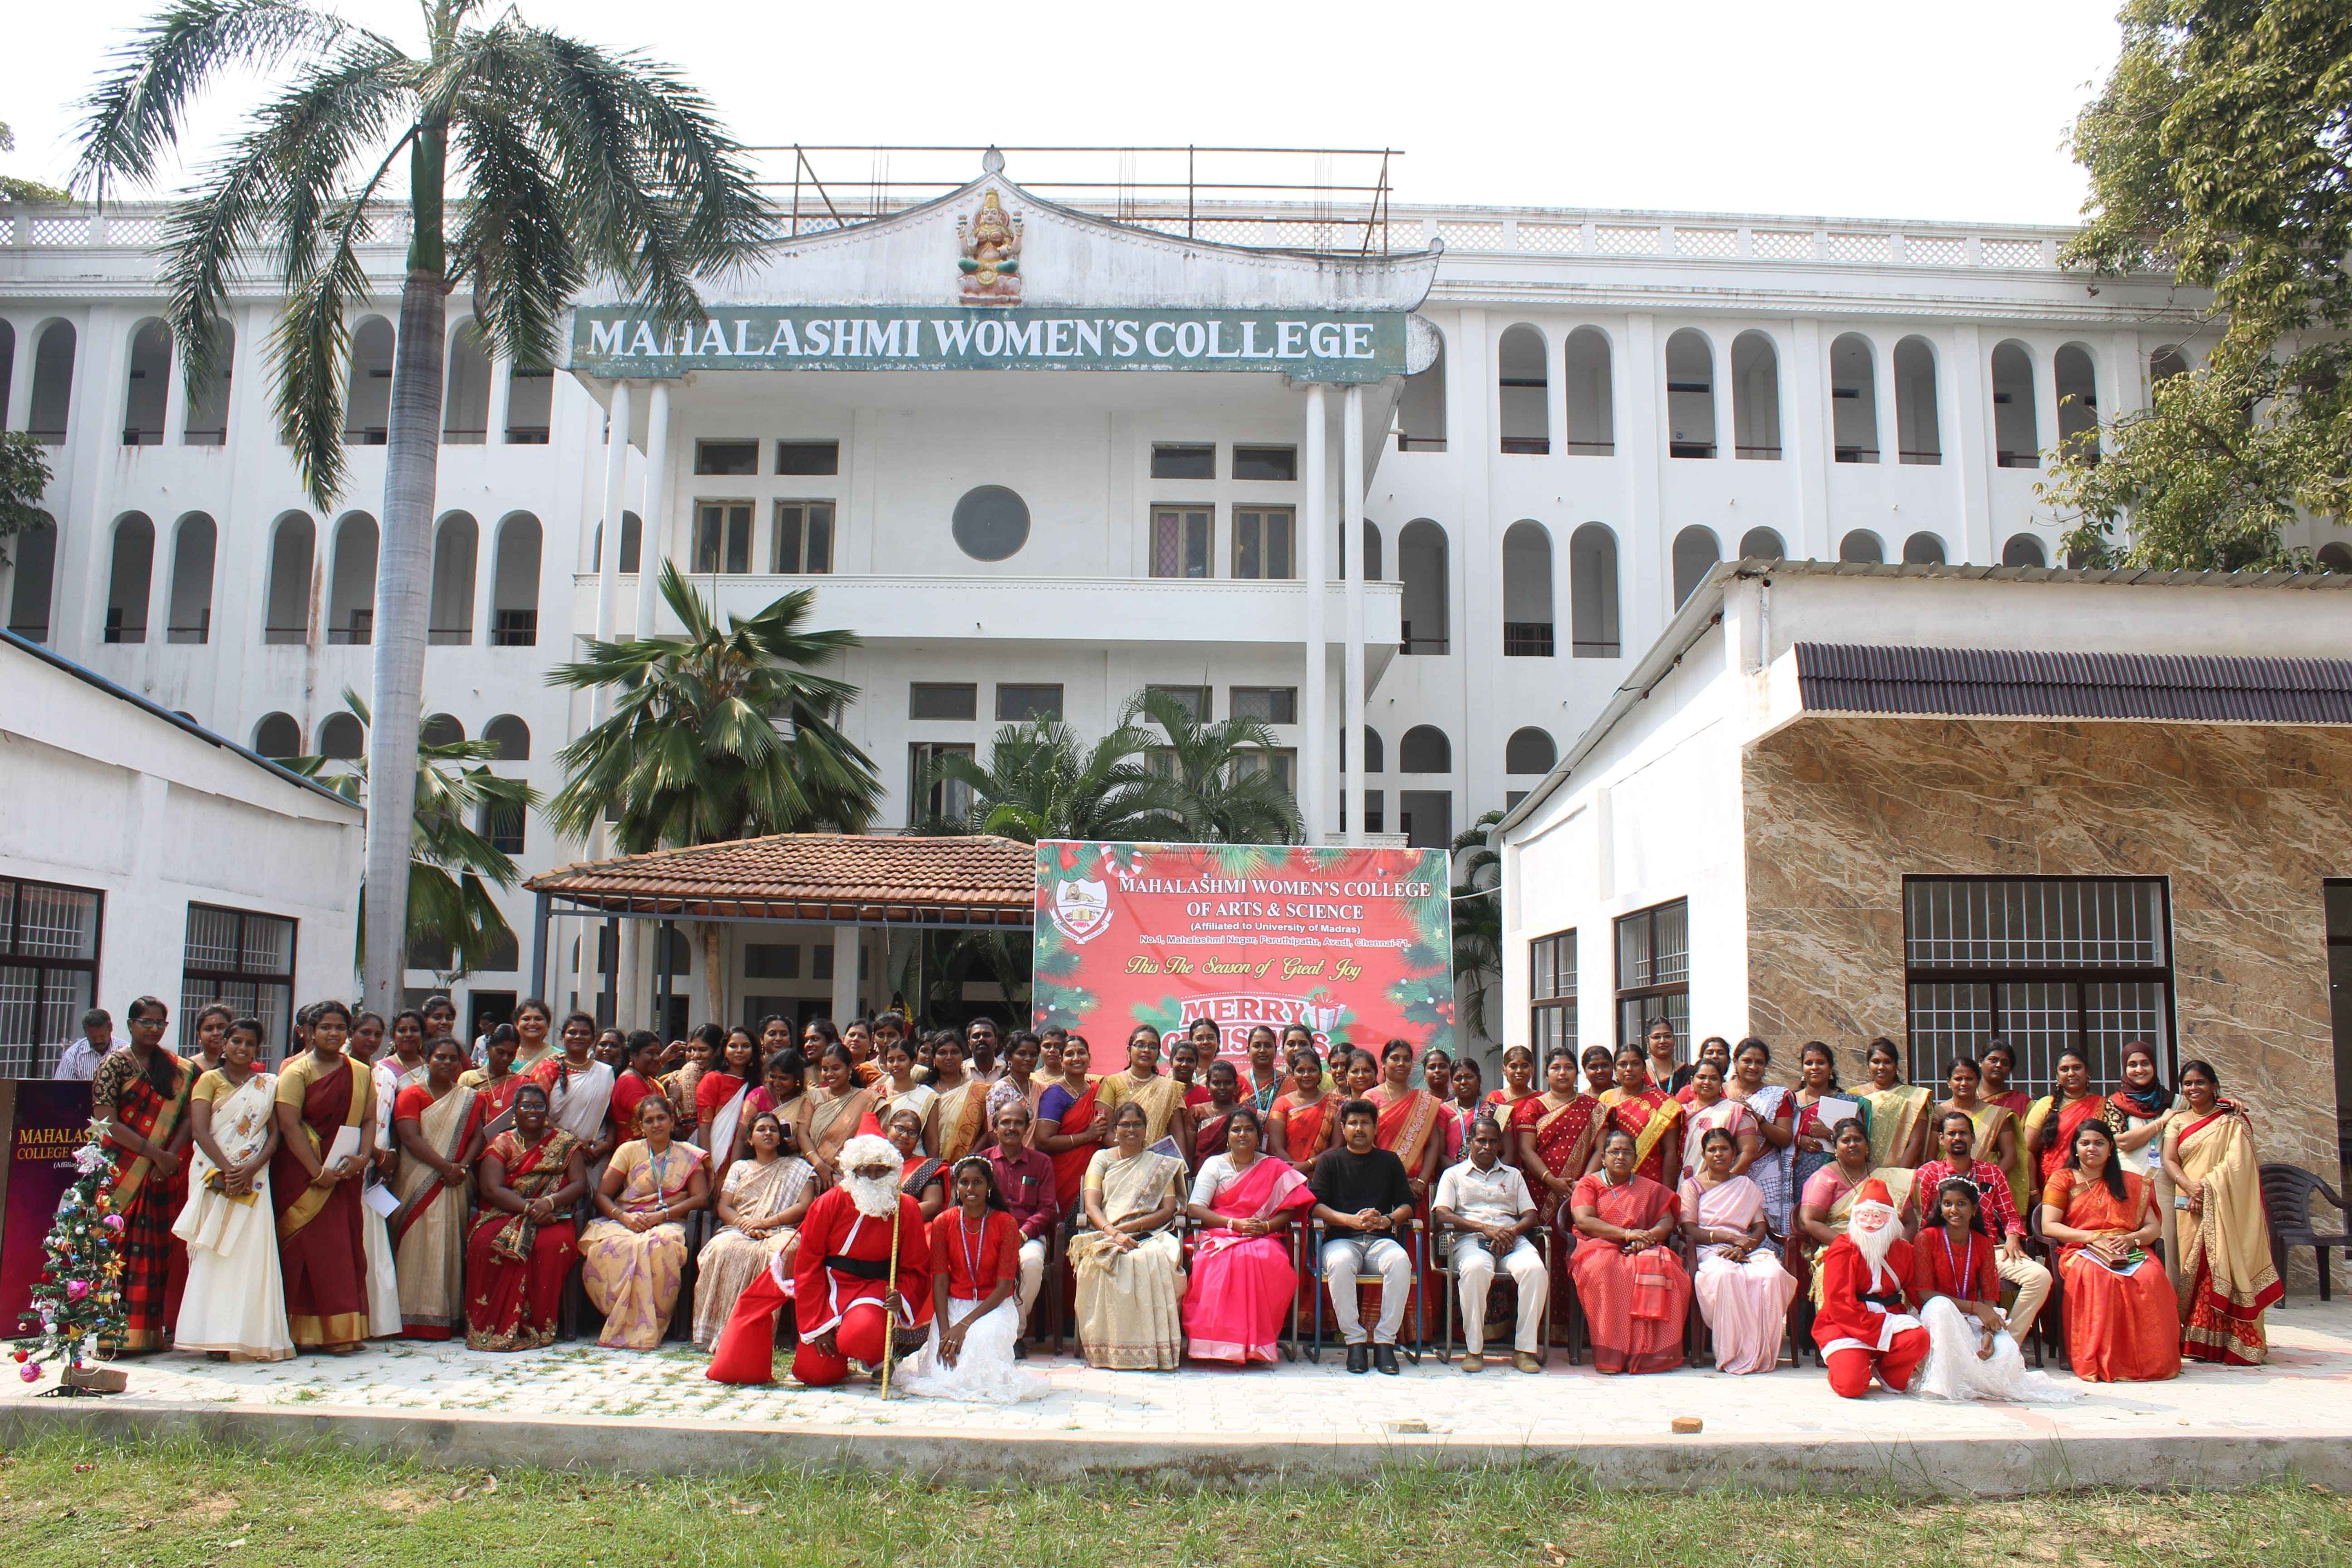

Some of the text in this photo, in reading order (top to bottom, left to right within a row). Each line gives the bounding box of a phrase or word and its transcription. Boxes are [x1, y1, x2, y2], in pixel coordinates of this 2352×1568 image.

[587, 319, 1375, 359] MAHALASHMI WOMEN'S COLLEGE
[1119, 878, 1431, 897] MAHALASHMI WOMEN'S COLLEGE
[1186, 902, 1364, 920] OF ARTS & SCIENCE
[1191, 922, 1240, 931] (Affiliated
[1255, 922, 1305, 933] University
[1308, 924, 1318, 932] of
[1321, 924, 1361, 934] Madras)
[1140, 935, 1411, 947] No.1, Mahalashmi Nagar, Paruthipattu, Avadi, Chennai-71.
[1125, 955, 1362, 982] This The Season of Great Joy
[1181, 997, 1305, 1026] MERRY
[17, 1147, 69, 1160] COLLEGE
